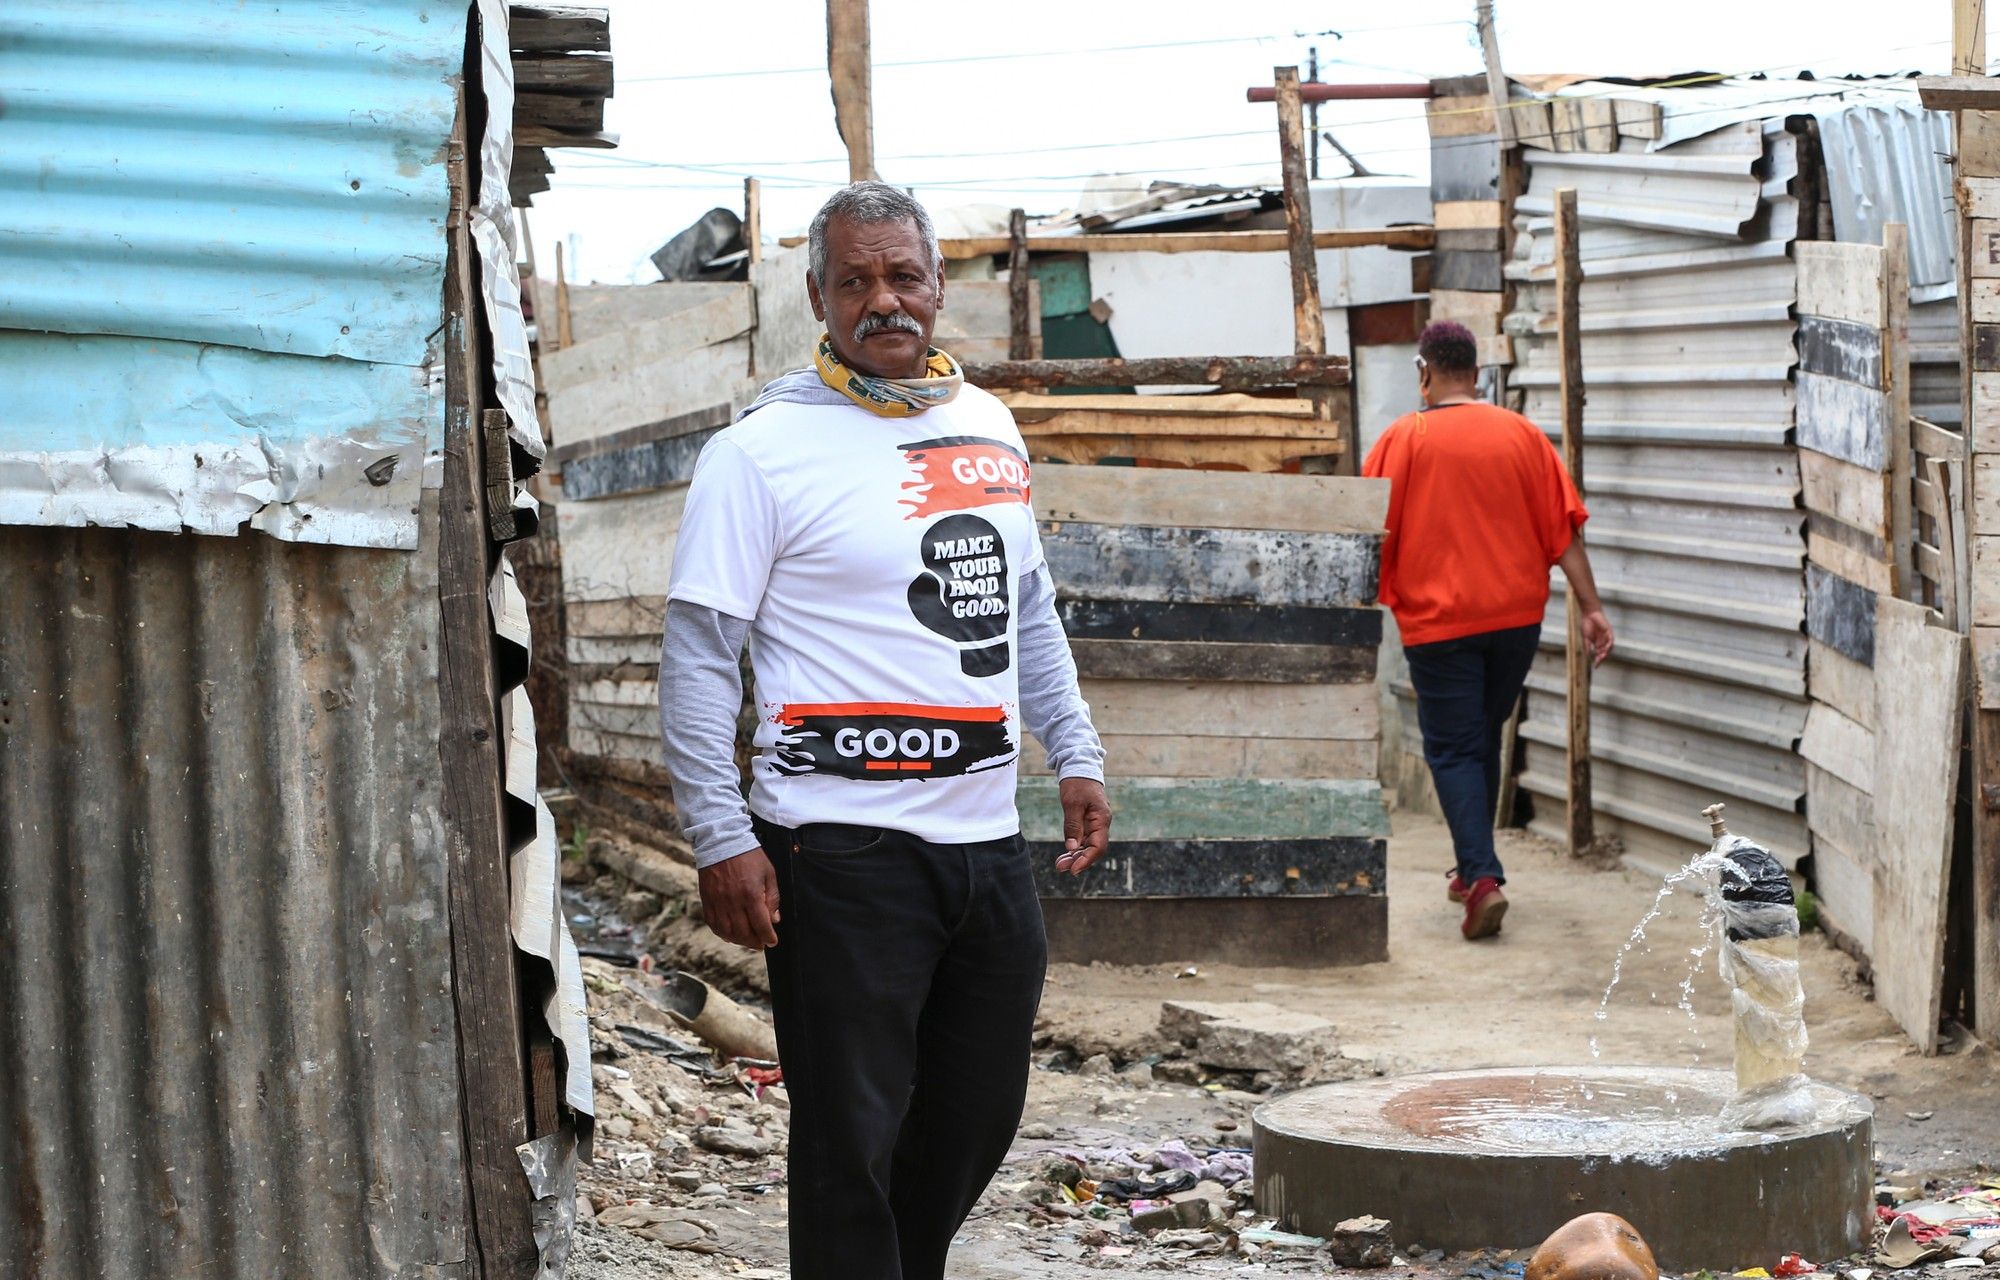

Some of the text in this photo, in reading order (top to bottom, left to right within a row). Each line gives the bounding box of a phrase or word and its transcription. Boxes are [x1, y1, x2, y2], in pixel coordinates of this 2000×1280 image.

[933, 534, 994, 560] MAKE
[949, 556, 1002, 579] YOUR
[949, 576, 1000, 597] HOOD
[952, 597, 1008, 619] GOOD.
[834, 727, 960, 759] GOOD
